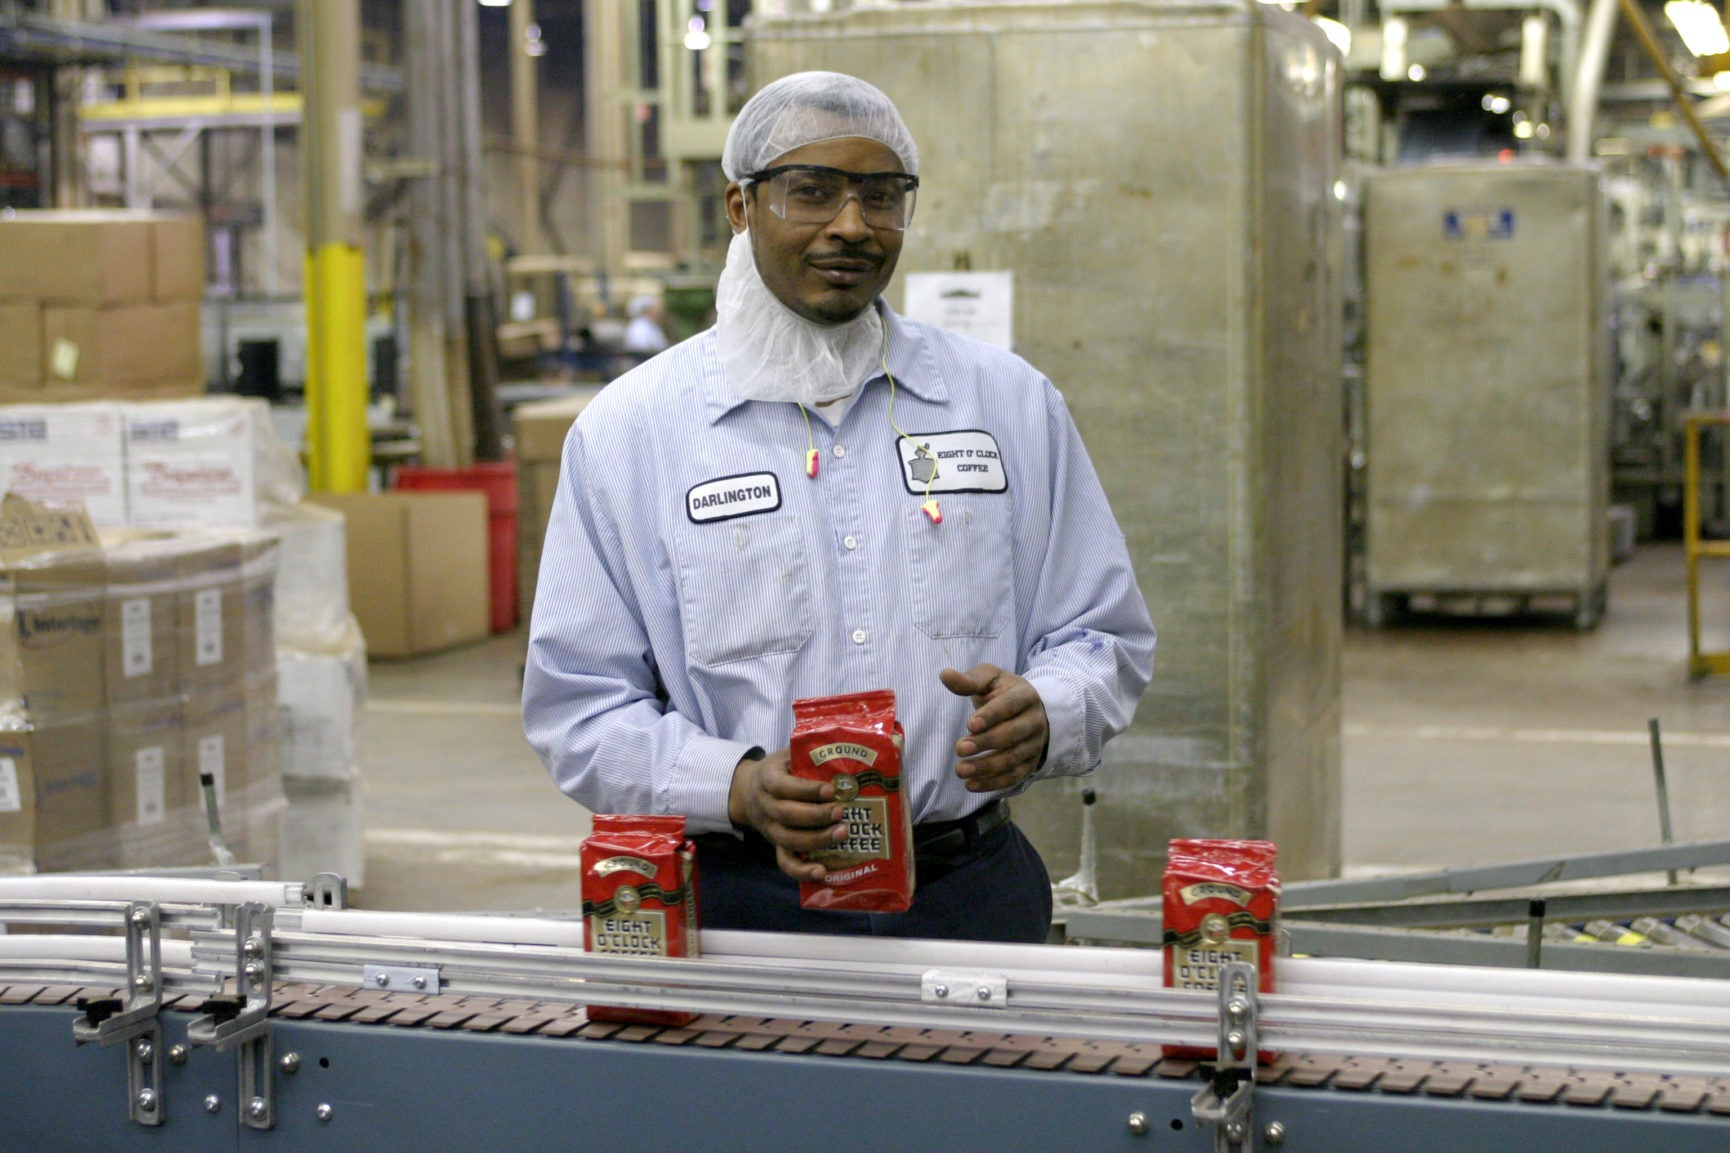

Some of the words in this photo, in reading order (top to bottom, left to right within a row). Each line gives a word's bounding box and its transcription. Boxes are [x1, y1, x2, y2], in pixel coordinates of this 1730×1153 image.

[937, 449, 965, 459] EIGHT
[976, 449, 999, 459] CLOCK
[957, 464, 989, 472] COFFEE
[693, 485, 771, 510] DARLINGTON
[819, 745, 867, 759] GROUND
[842, 808, 871, 821] GHT
[824, 864, 878, 882] ORIGINAL
[606, 920, 650, 932] EIGHT
[598, 934, 659, 948] O'CLOCK
[1190, 950, 1241, 963] EIGHT
[1181, 965, 1217, 979] O'CL
